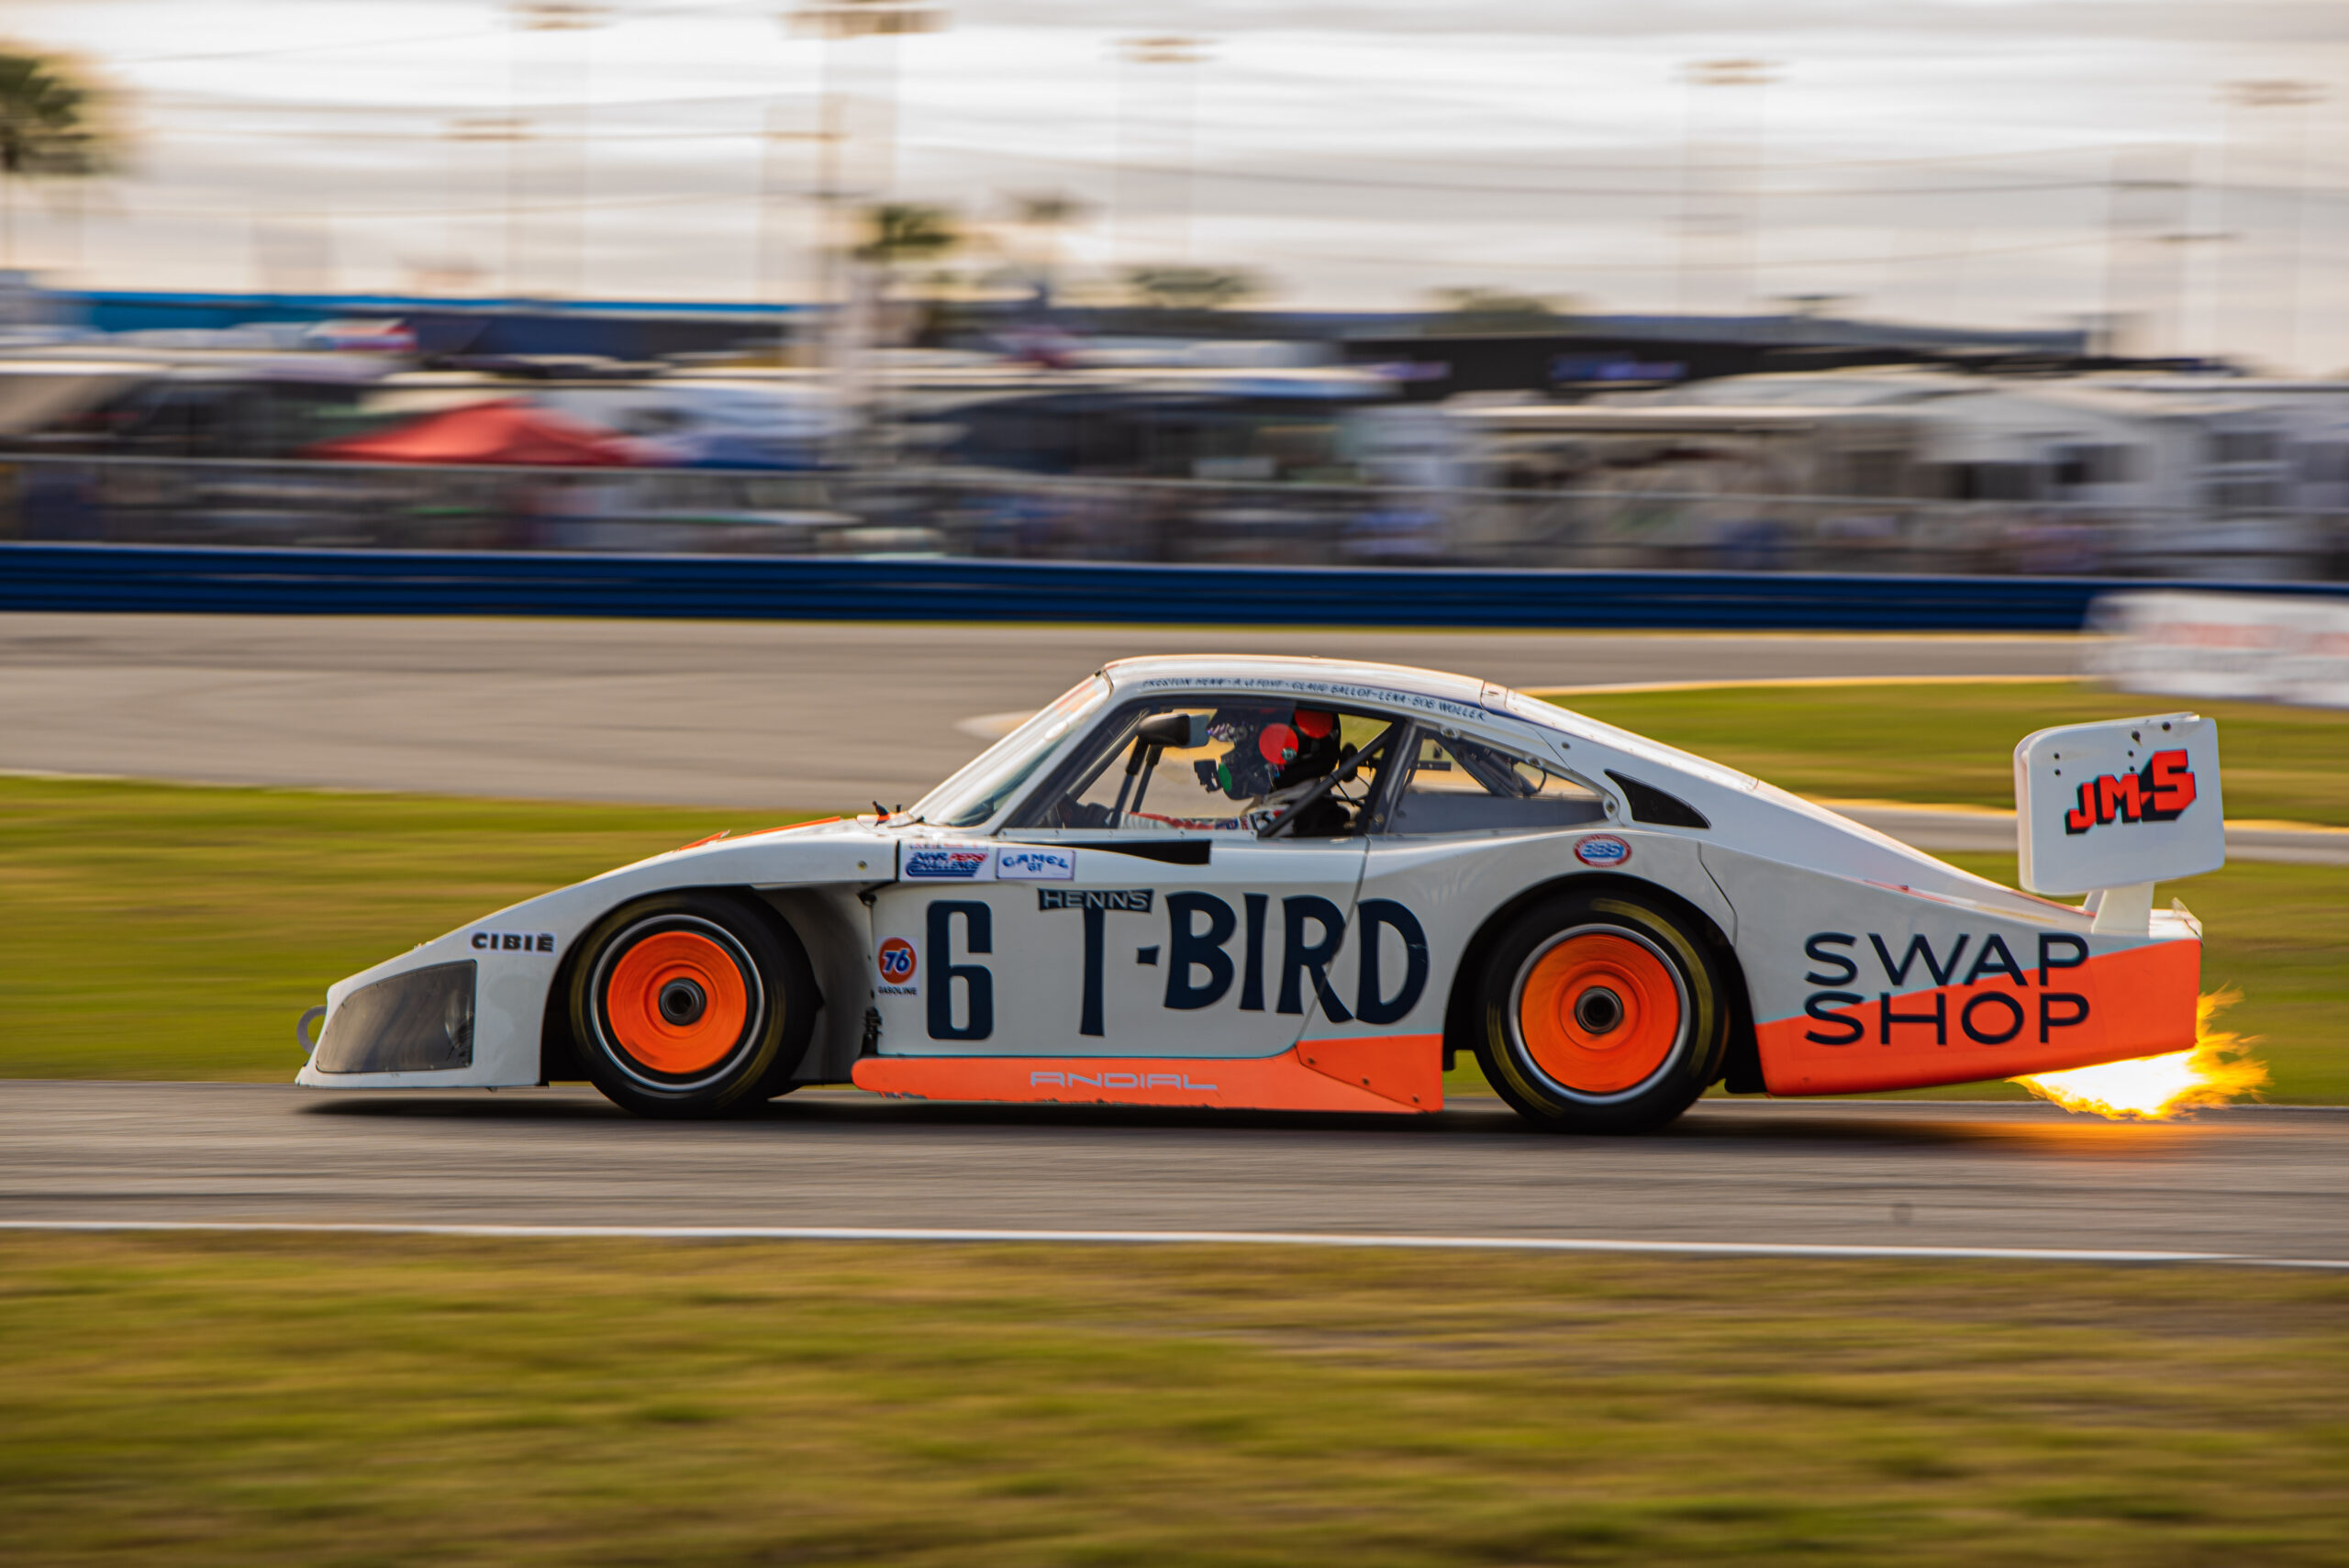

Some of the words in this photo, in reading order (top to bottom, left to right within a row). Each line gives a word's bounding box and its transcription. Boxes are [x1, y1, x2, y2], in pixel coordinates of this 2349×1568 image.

[1581, 841, 1625, 858] BBS
[1001, 853, 1069, 870] CAMEL
[1028, 862, 1042, 873] GT
[883, 948, 911, 974] 76
[927, 900, 994, 1040] 6
[1039, 889, 1431, 1038] T-BIRD
[1804, 932, 2090, 987] SWAP
[878, 985, 918, 996] GASOLINE
[1804, 991, 2090, 1045] SHOP
[1030, 1071, 1219, 1091] ANDIAL
